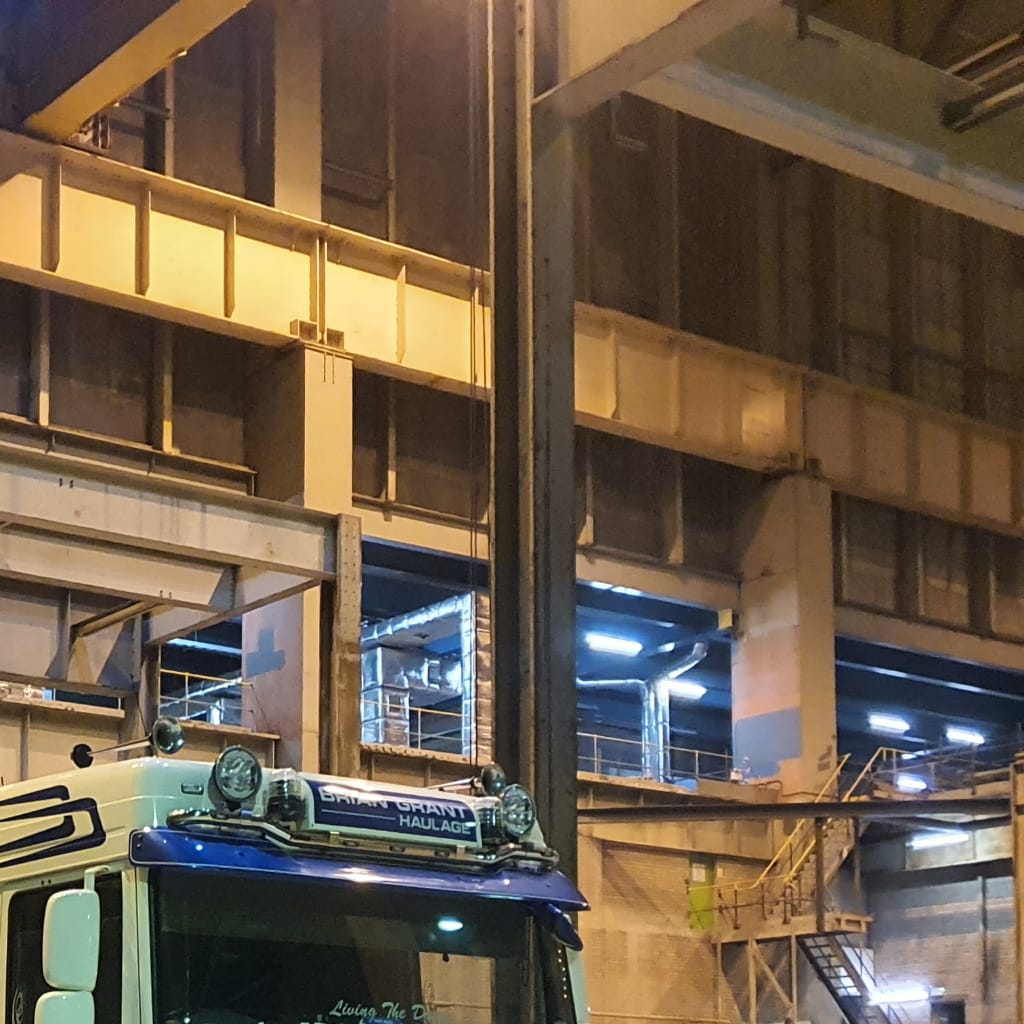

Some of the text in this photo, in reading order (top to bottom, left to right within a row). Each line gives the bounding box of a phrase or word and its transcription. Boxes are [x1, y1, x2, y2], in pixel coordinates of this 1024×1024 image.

[396, 800, 466, 819] GRANT
[399, 814, 472, 835] HAULAGE
[329, 1000, 377, 1021] Living
[381, 1001, 407, 1019] The
